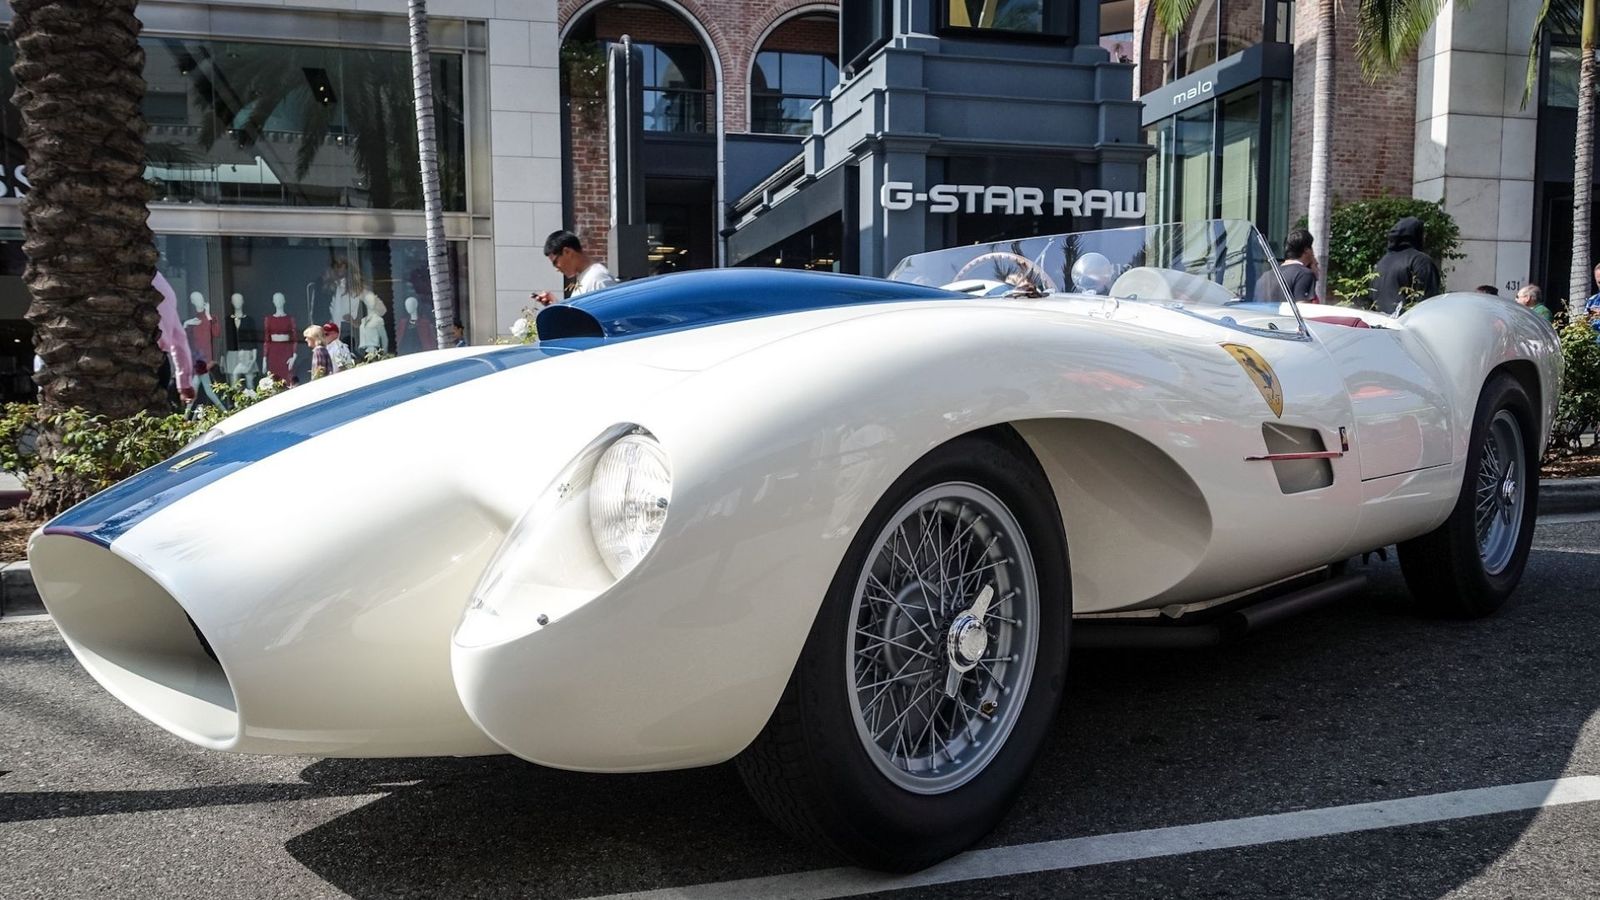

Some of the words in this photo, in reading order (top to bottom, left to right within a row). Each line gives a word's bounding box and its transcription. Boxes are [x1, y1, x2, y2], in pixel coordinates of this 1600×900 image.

[1173, 81, 1213, 105] malo
[880, 181, 1044, 215] G-STAR
[1053, 188, 1146, 218] RAW
[1505, 281, 1520, 291] 431
